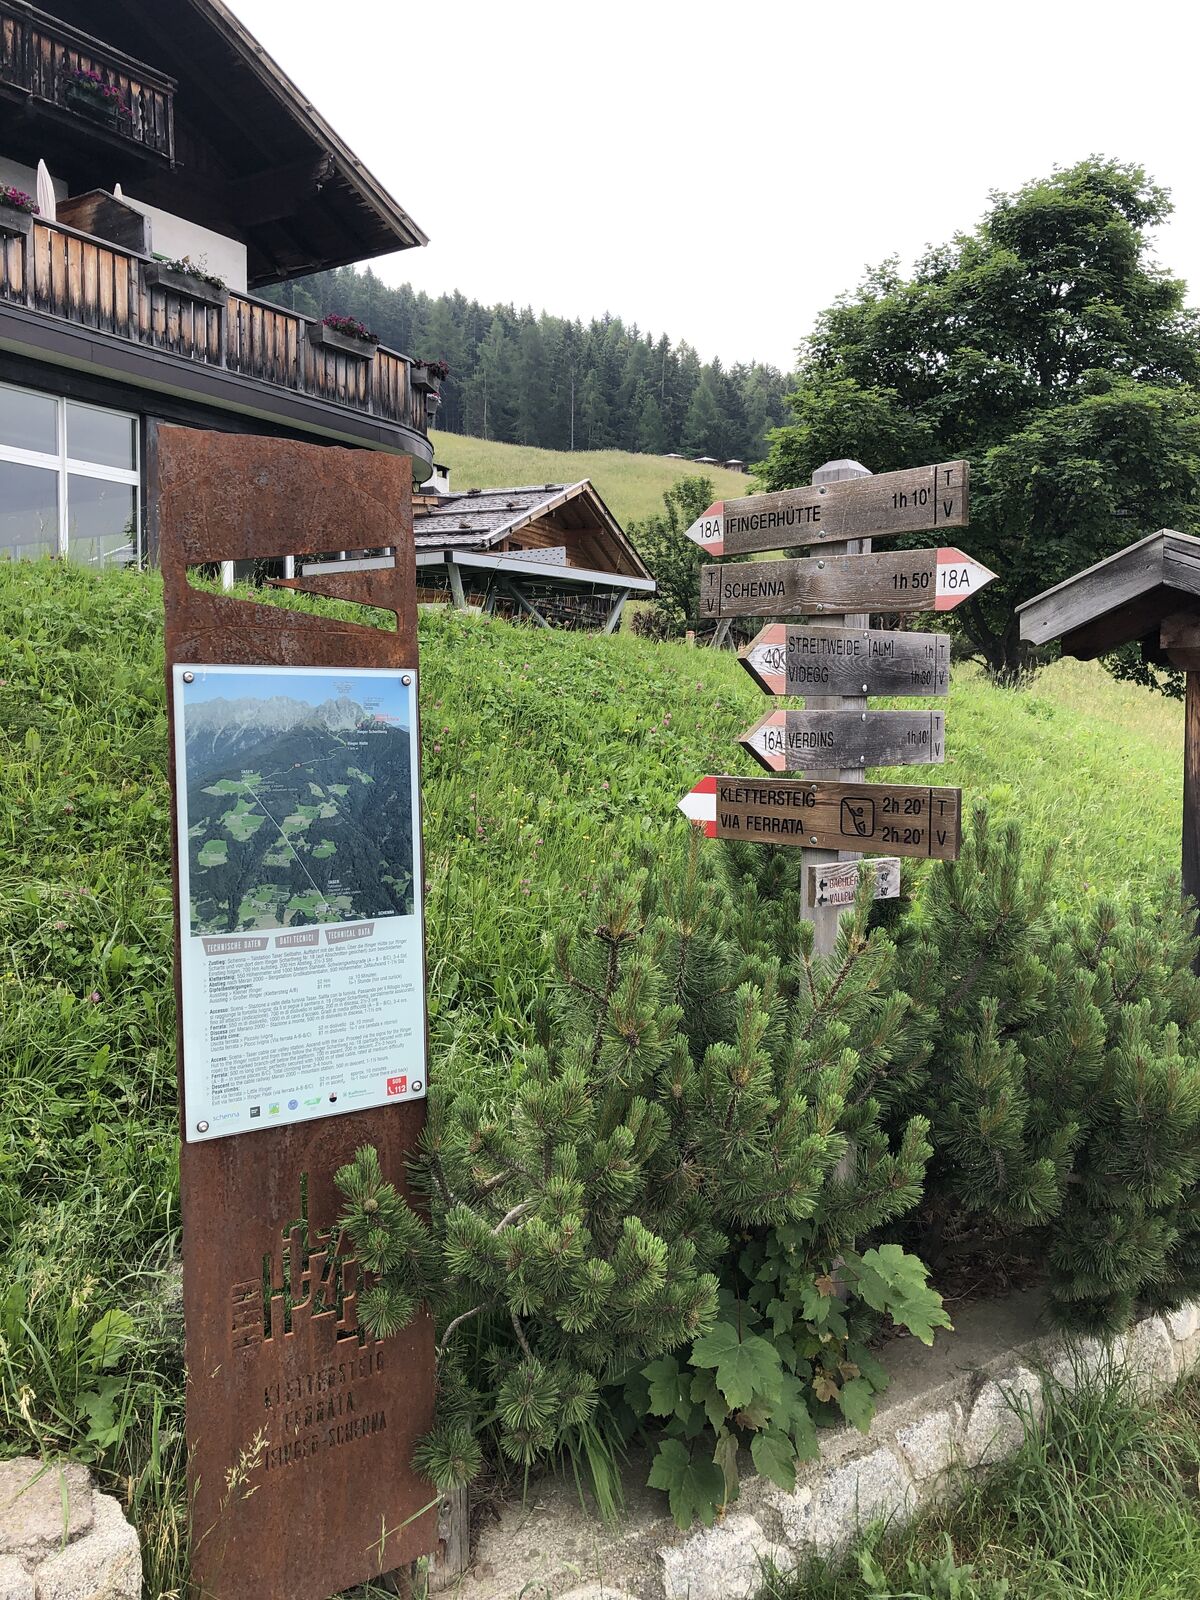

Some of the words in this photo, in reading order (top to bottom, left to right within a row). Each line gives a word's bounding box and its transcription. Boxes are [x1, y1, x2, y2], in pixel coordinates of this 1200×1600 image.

[944, 470, 954, 486] T
[726, 505, 822, 534] IFINGERHÜTTE
[892, 492, 907, 508] 1h
[912, 488, 931, 506] 10'
[944, 501, 953, 518] V
[700, 520, 720, 538] 18A
[708, 572, 715, 587] T
[724, 581, 786, 598] SCHENNA
[892, 574, 908, 590] 1h
[912, 572, 932, 588] 50'
[940, 570, 970, 588] 18A
[706, 598, 714, 613] V
[788, 636, 860, 656] STREITWEIDE
[868, 639, 894, 658] [ALM]
[925, 644, 934, 658] 1h
[940, 644, 945, 659] T
[788, 666, 829, 684] VIDEGG
[910, 670, 920, 683] 1h
[938, 672, 945, 686] V
[935, 716, 940, 730] T
[763, 730, 783, 750] 16A
[788, 731, 834, 748] VERDINS
[907, 730, 916, 744] 1h
[918, 729, 930, 744] 10'
[934, 742, 941, 757] V
[720, 788, 816, 808] KLETTERSTEIG
[882, 796, 900, 814] 2h
[904, 798, 925, 816] 20'
[938, 800, 948, 817] T
[720, 814, 740, 830] VIA
[746, 816, 804, 835] FERRATA
[882, 826, 899, 844] 2h
[904, 828, 924, 845] 20'
[937, 830, 947, 846] V
[280, 936, 292, 946] DATI
[293, 934, 314, 944] TECNICI
[328, 929, 354, 940] TECHNICAL
[358, 928, 370, 937] DATA
[207, 941, 241, 953] TECHNISCHE
[244, 939, 262, 950] DATEN
[395, 1085, 406, 1093] 112
[212, 1112, 240, 1122] schenna
[264, 1351, 385, 1410] KLETTERSTEIG
[285, 1391, 355, 1432] FERRATA
